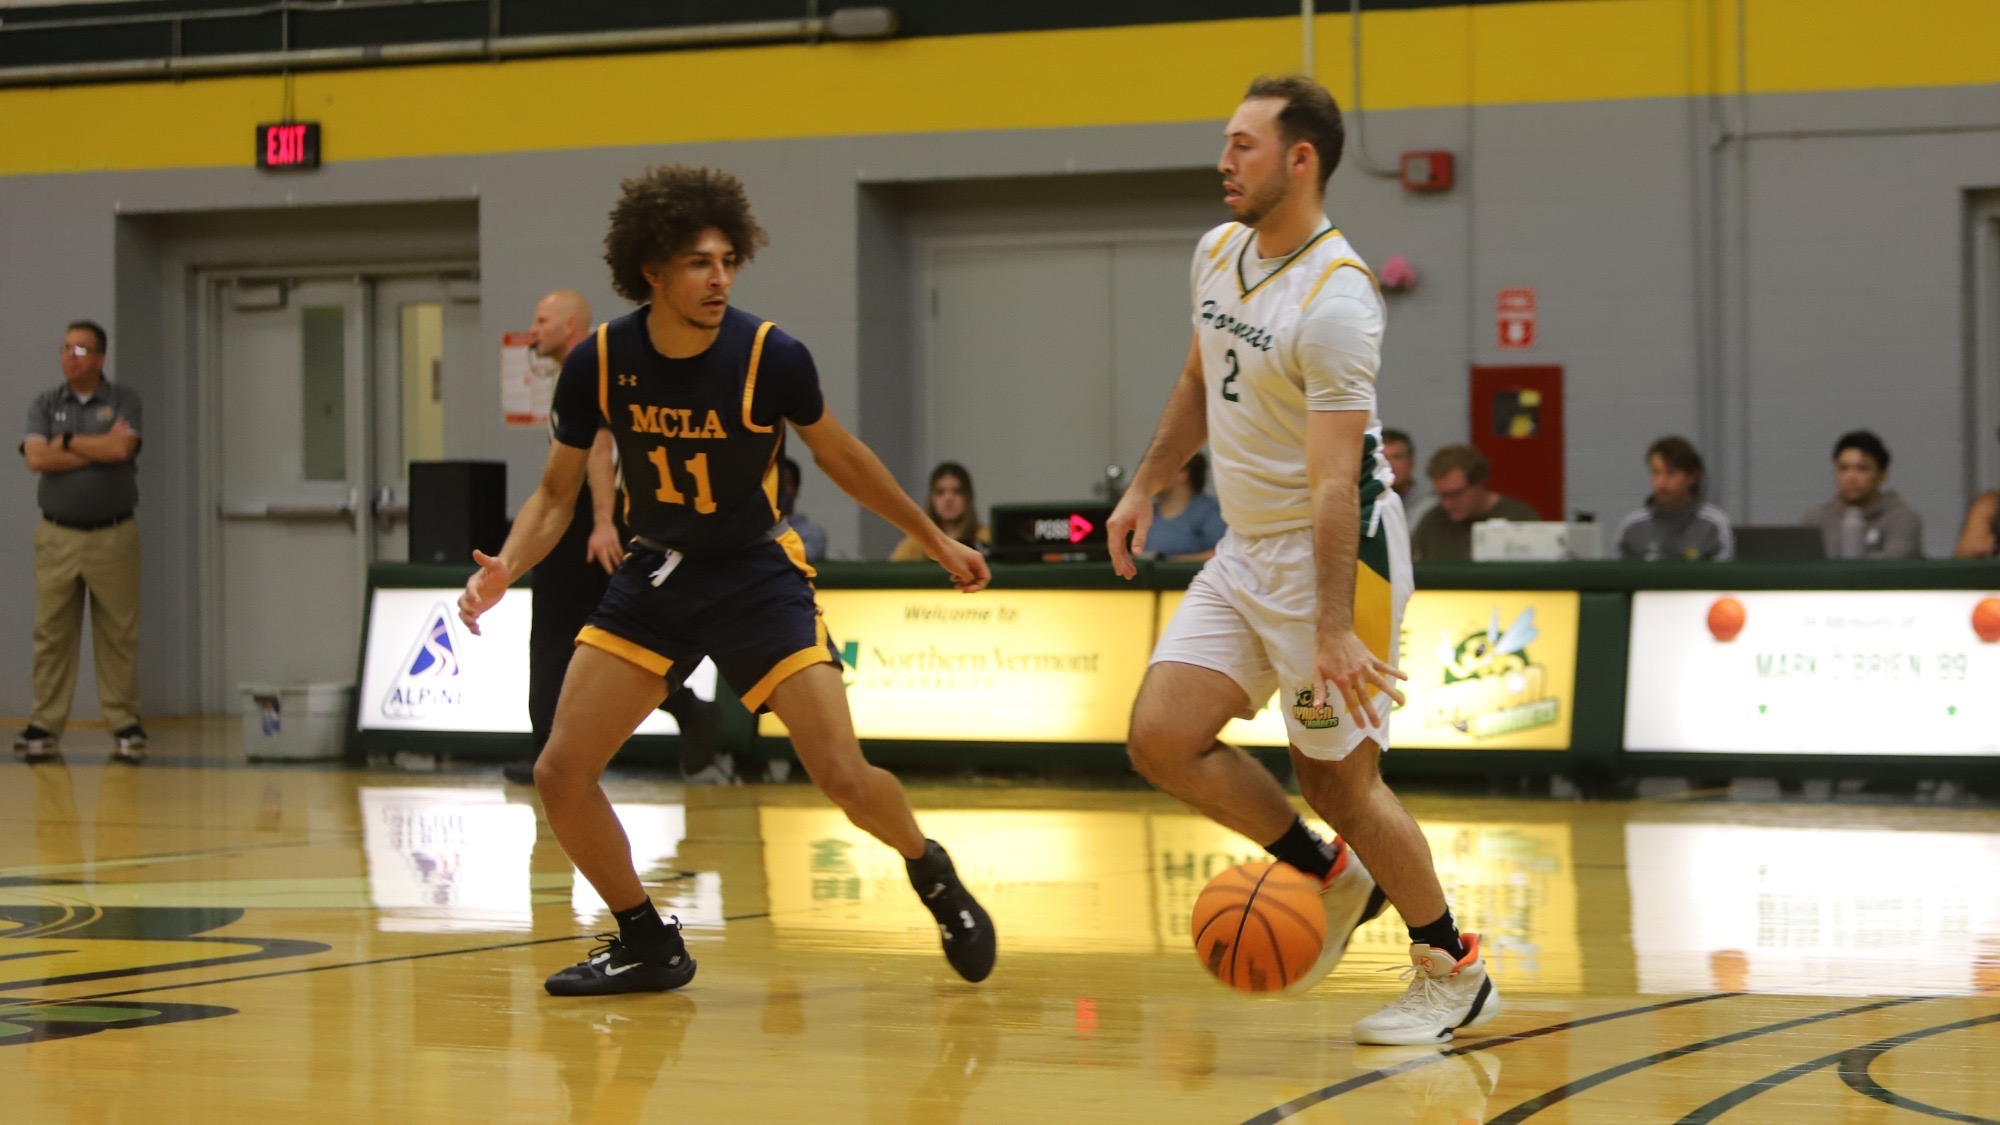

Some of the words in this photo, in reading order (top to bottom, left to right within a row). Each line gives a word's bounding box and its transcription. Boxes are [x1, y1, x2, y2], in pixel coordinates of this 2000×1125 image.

[267, 124, 306, 165] EXIT
[1201, 300, 1273, 351] Hornets
[1222, 349, 1239, 402] 2
[628, 404, 727, 439] MCLA
[647, 445, 717, 514] 11
[903, 603, 991, 623] Welcome
[997, 605, 1018, 623] to
[869, 645, 986, 672] Northern
[992, 646, 1099, 673] Vermont
